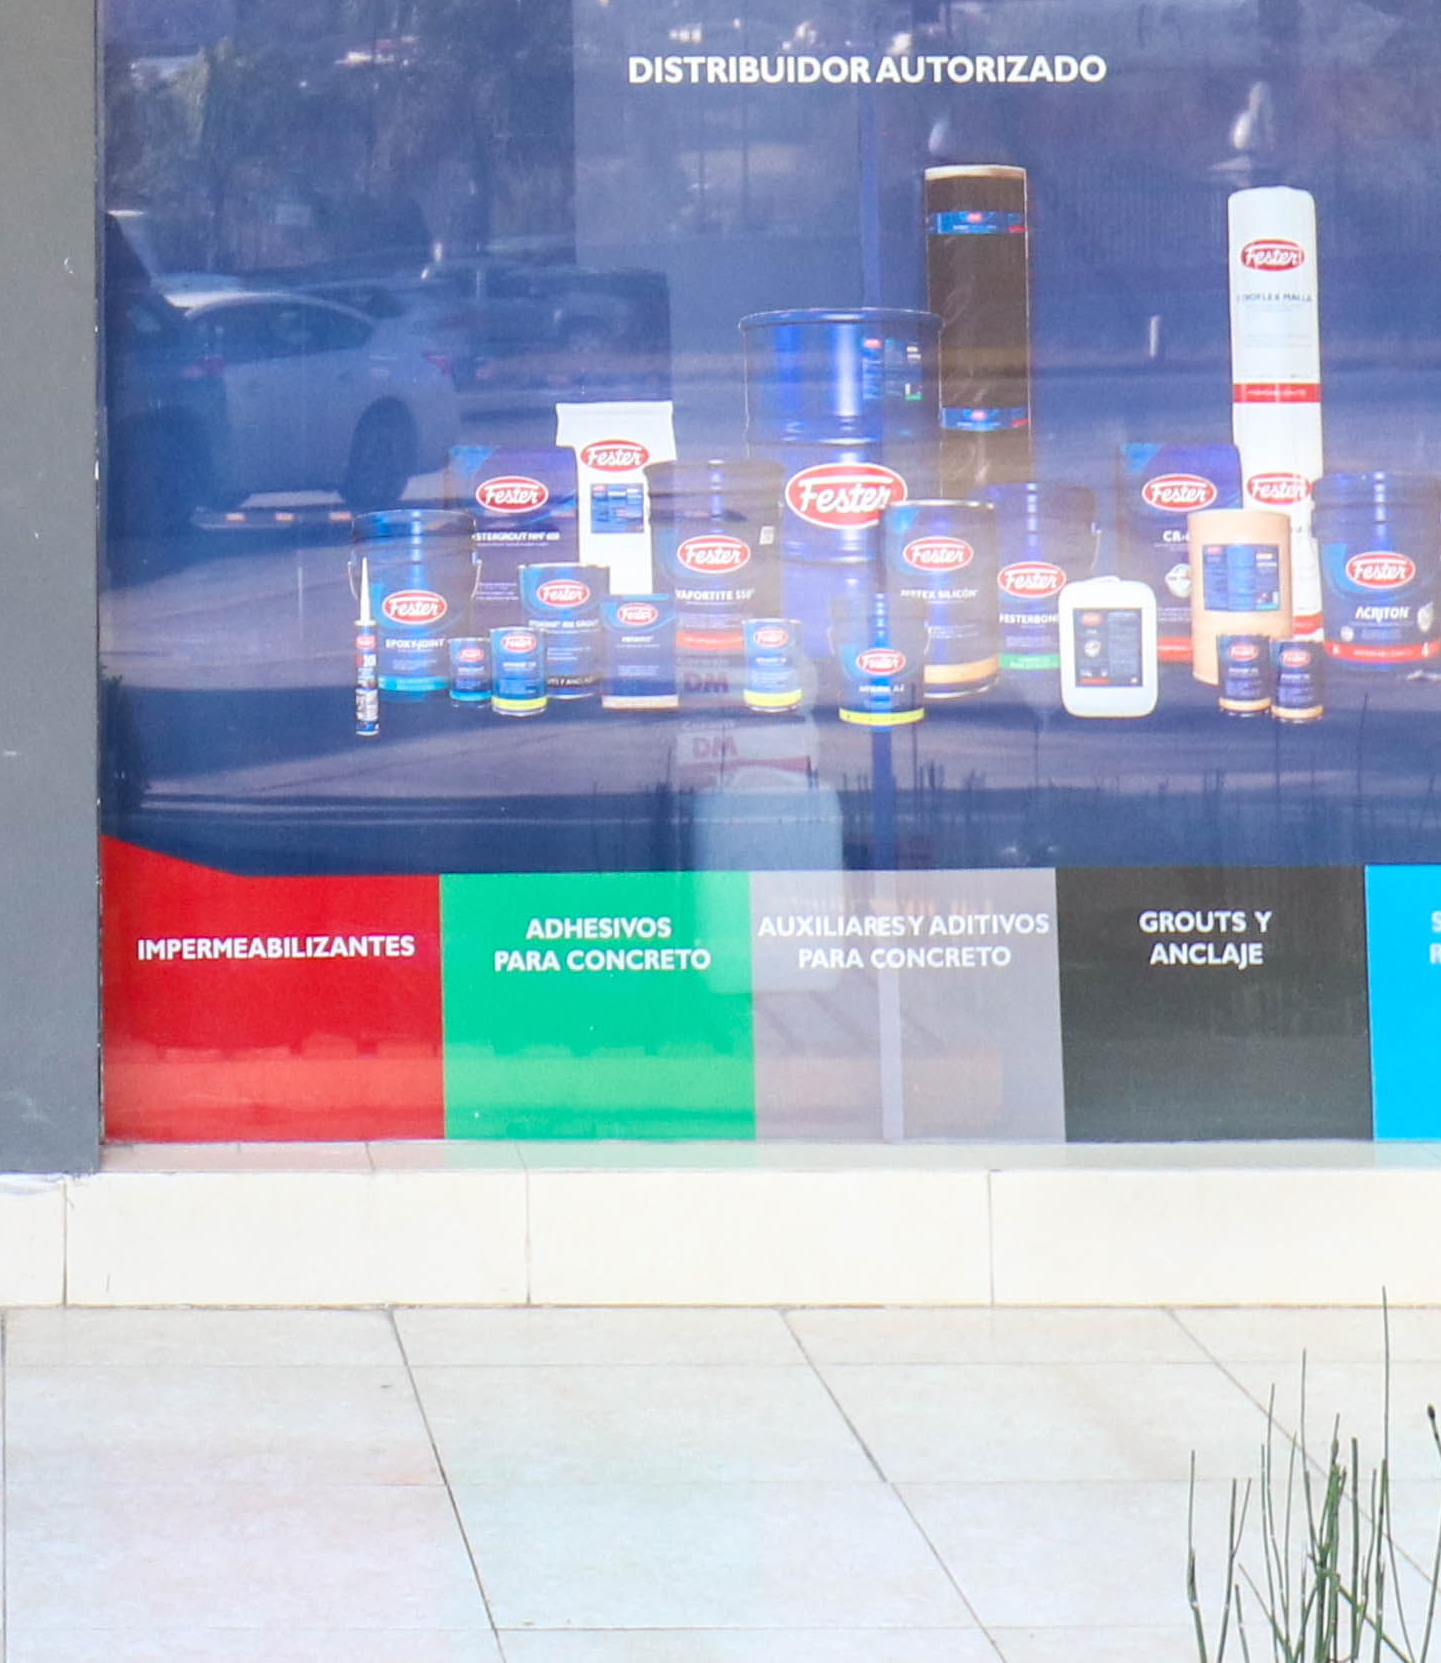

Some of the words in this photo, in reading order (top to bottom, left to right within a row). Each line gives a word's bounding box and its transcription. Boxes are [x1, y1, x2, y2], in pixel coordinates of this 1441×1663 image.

[628, 56, 871, 85] DISTRIBUIDOR
[876, 56, 1106, 85] AUTORIZADO
[525, 916, 673, 941] ADHESIVOS
[758, 913, 904, 937] AUXILIARES
[904, 912, 923, 936] Y
[928, 911, 1052, 936] ADITIVOS
[1138, 911, 1250, 935] GROUTS
[1255, 910, 1273, 934] Y
[137, 935, 416, 962] IMPERMEABILIZANTES
[494, 949, 562, 973] PARA
[567, 946, 712, 972] CONCRETO
[798, 946, 864, 970] PARA
[868, 945, 1011, 969] CONCRETO
[1150, 942, 1264, 969] ANCLAJE
